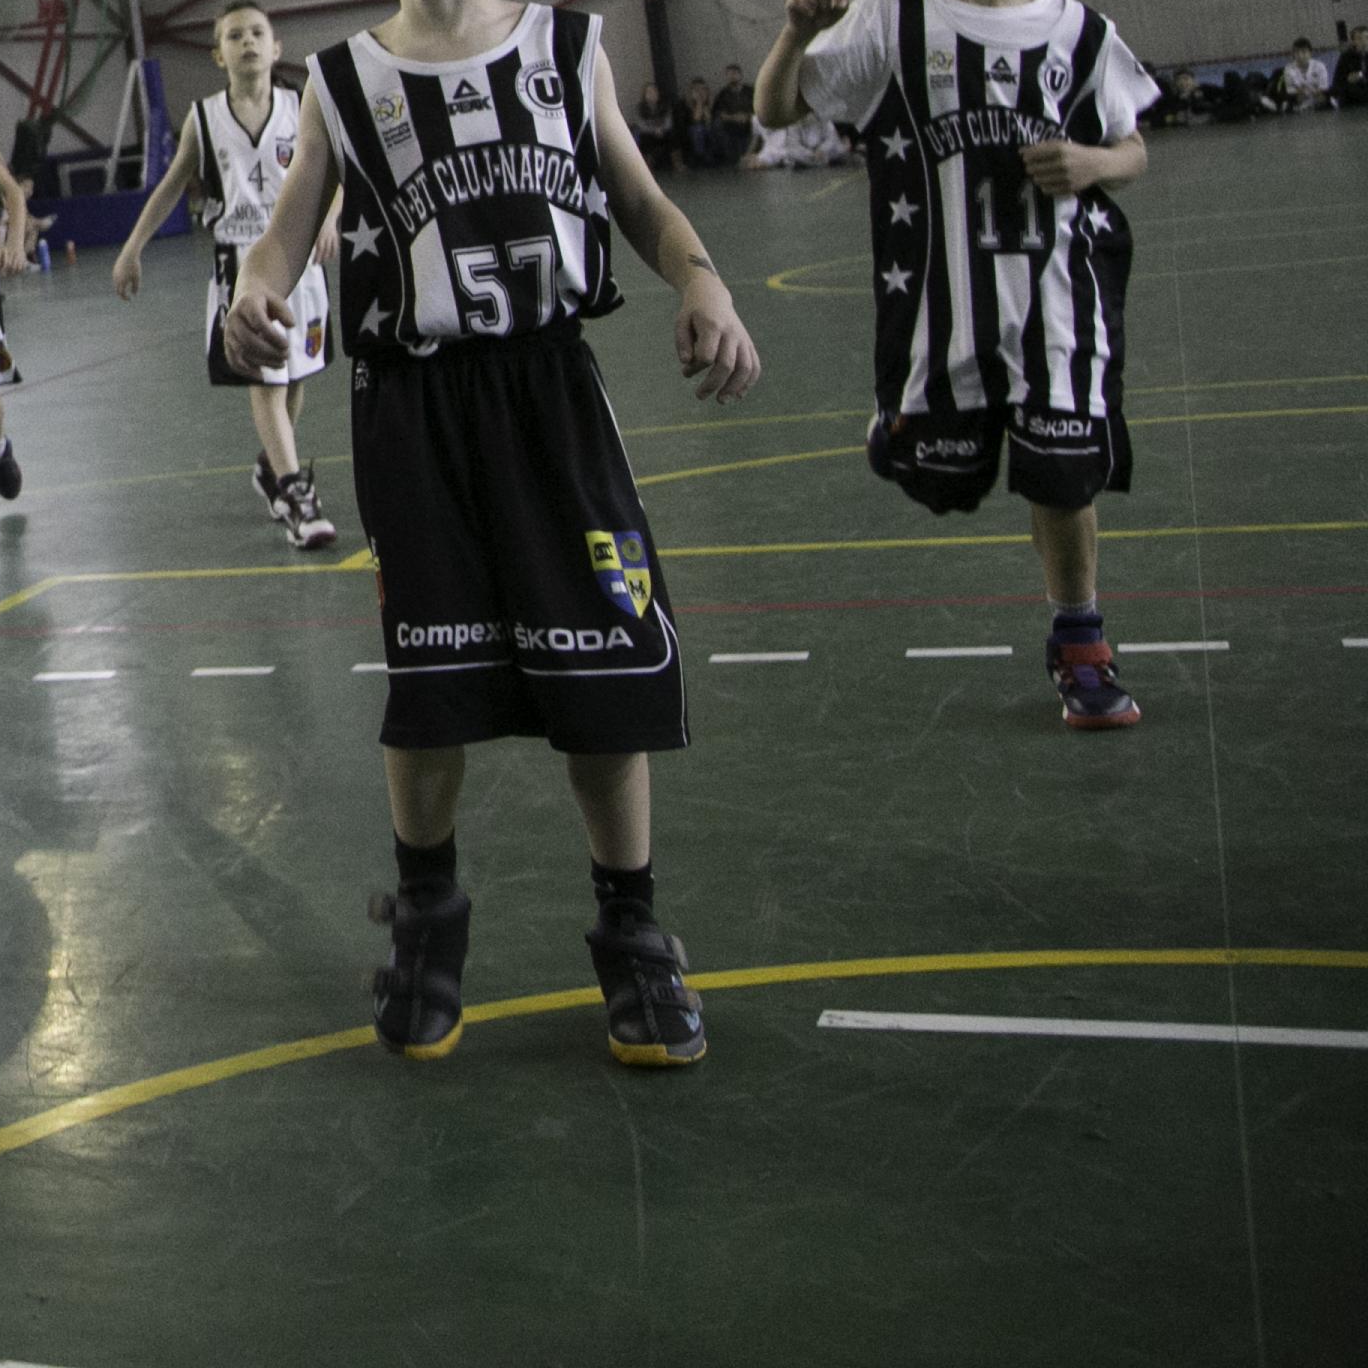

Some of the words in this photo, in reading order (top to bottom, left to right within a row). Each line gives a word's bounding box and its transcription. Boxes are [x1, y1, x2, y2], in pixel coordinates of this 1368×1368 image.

[247, 158, 270, 193] 4
[390, 171, 438, 234] U-BT
[432, 144, 586, 211] CLUJ-NAPOCA
[976, 181, 1045, 250] 11
[450, 234, 557, 336] 57
[515, 621, 635, 653] ŠKODA
